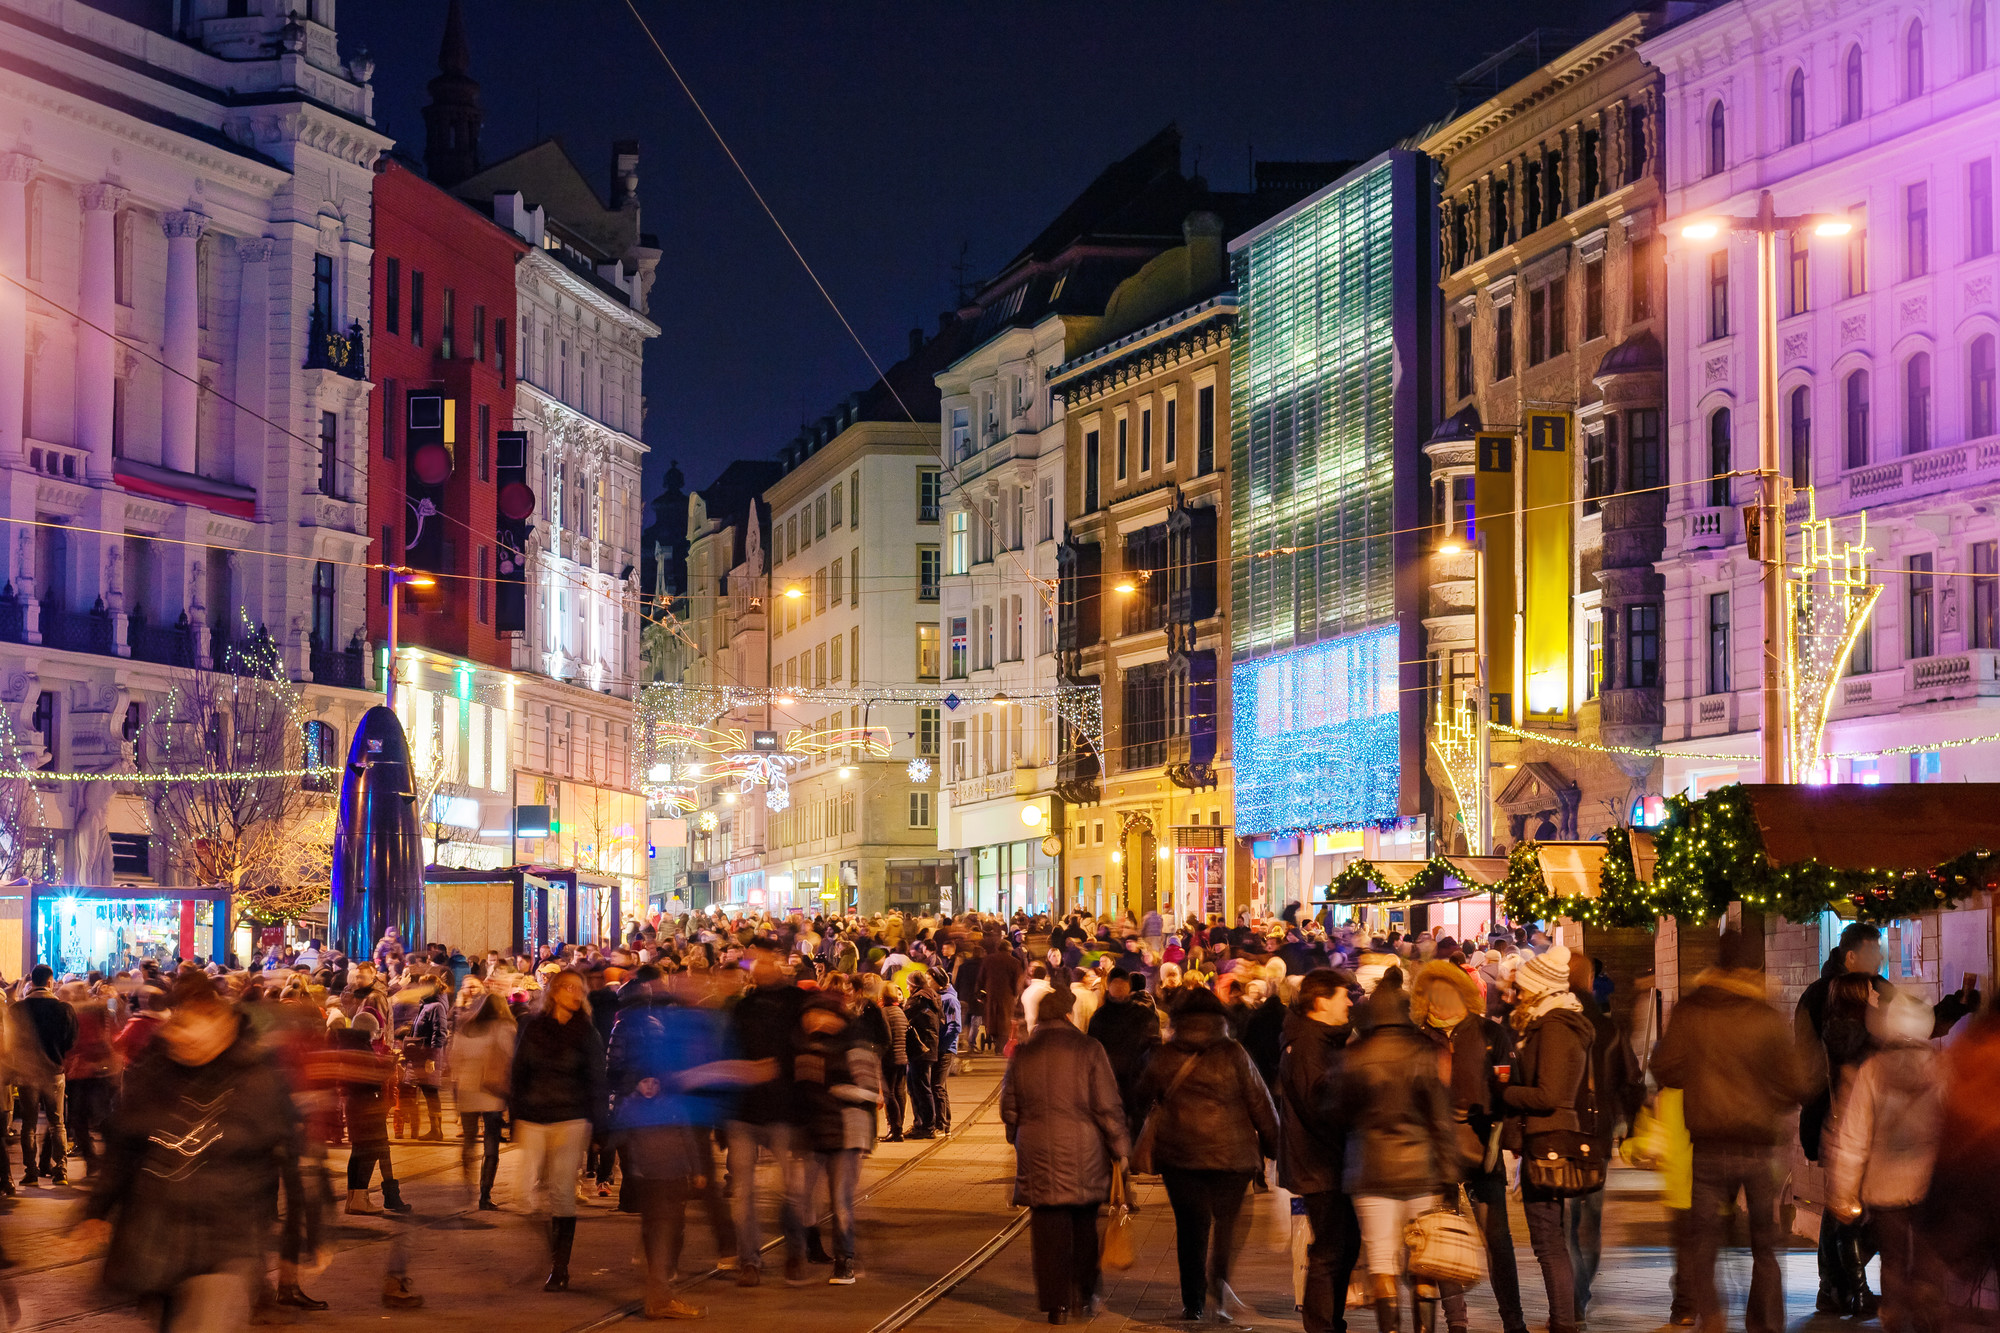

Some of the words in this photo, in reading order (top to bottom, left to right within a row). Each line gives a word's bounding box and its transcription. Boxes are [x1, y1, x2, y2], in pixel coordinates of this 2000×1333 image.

[1542, 420, 1554, 448] i
[1490, 441, 1500, 469] i
[1490, 696, 1500, 722] i
